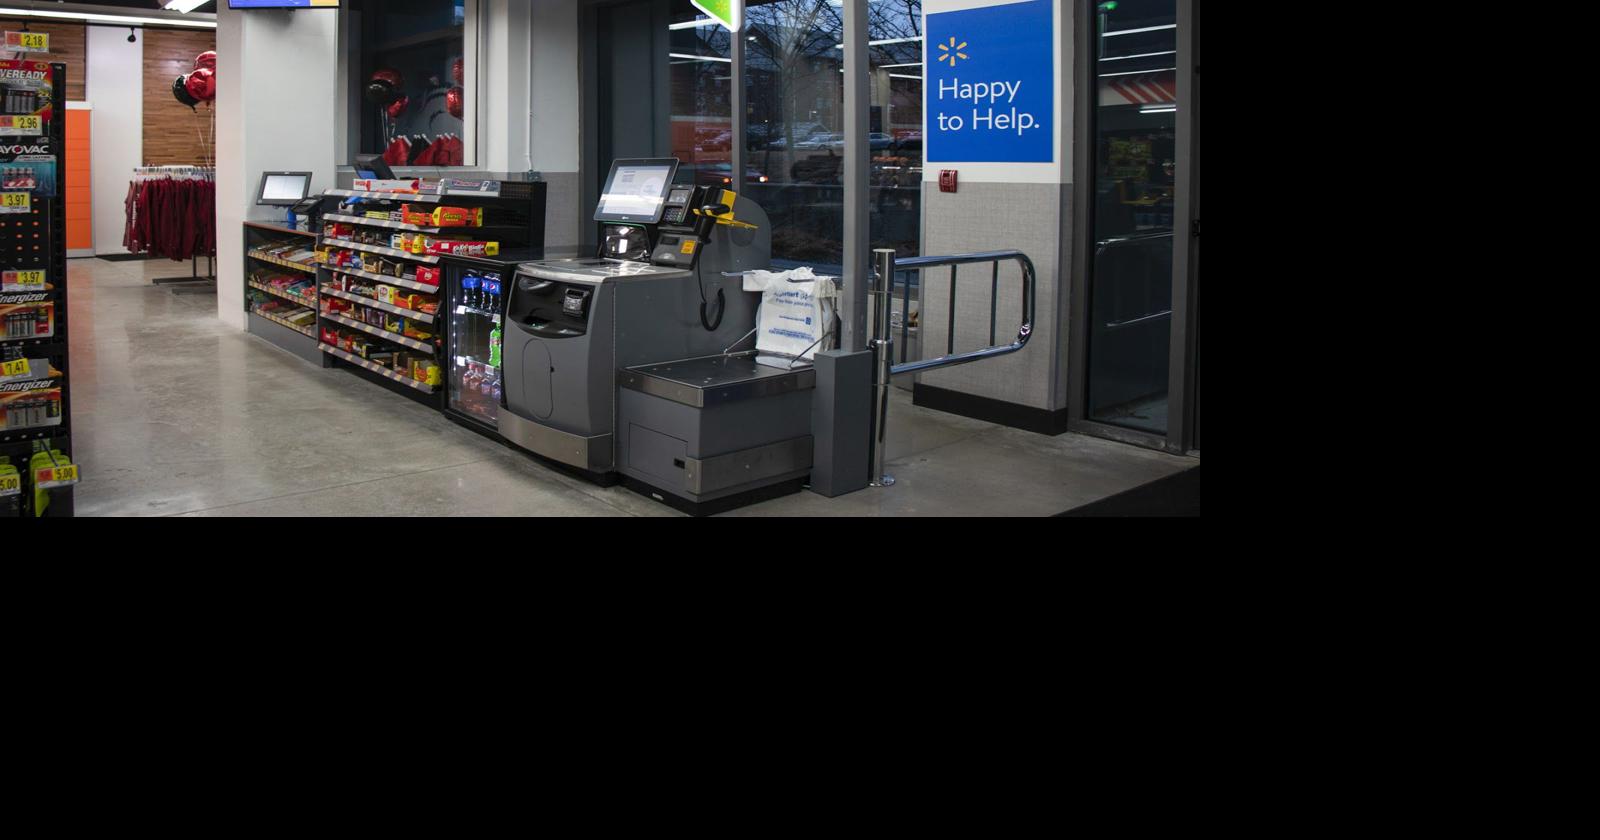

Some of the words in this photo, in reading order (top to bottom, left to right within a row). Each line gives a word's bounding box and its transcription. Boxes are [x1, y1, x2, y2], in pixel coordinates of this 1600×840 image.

[0, 69, 47, 80] VEREADY
[939, 78, 1021, 105] Happy
[937, 112, 963, 131] to
[972, 107, 1040, 136] Help.
[0, 145, 49, 154] AYOVAC
[0, 292, 48, 304] nergizer
